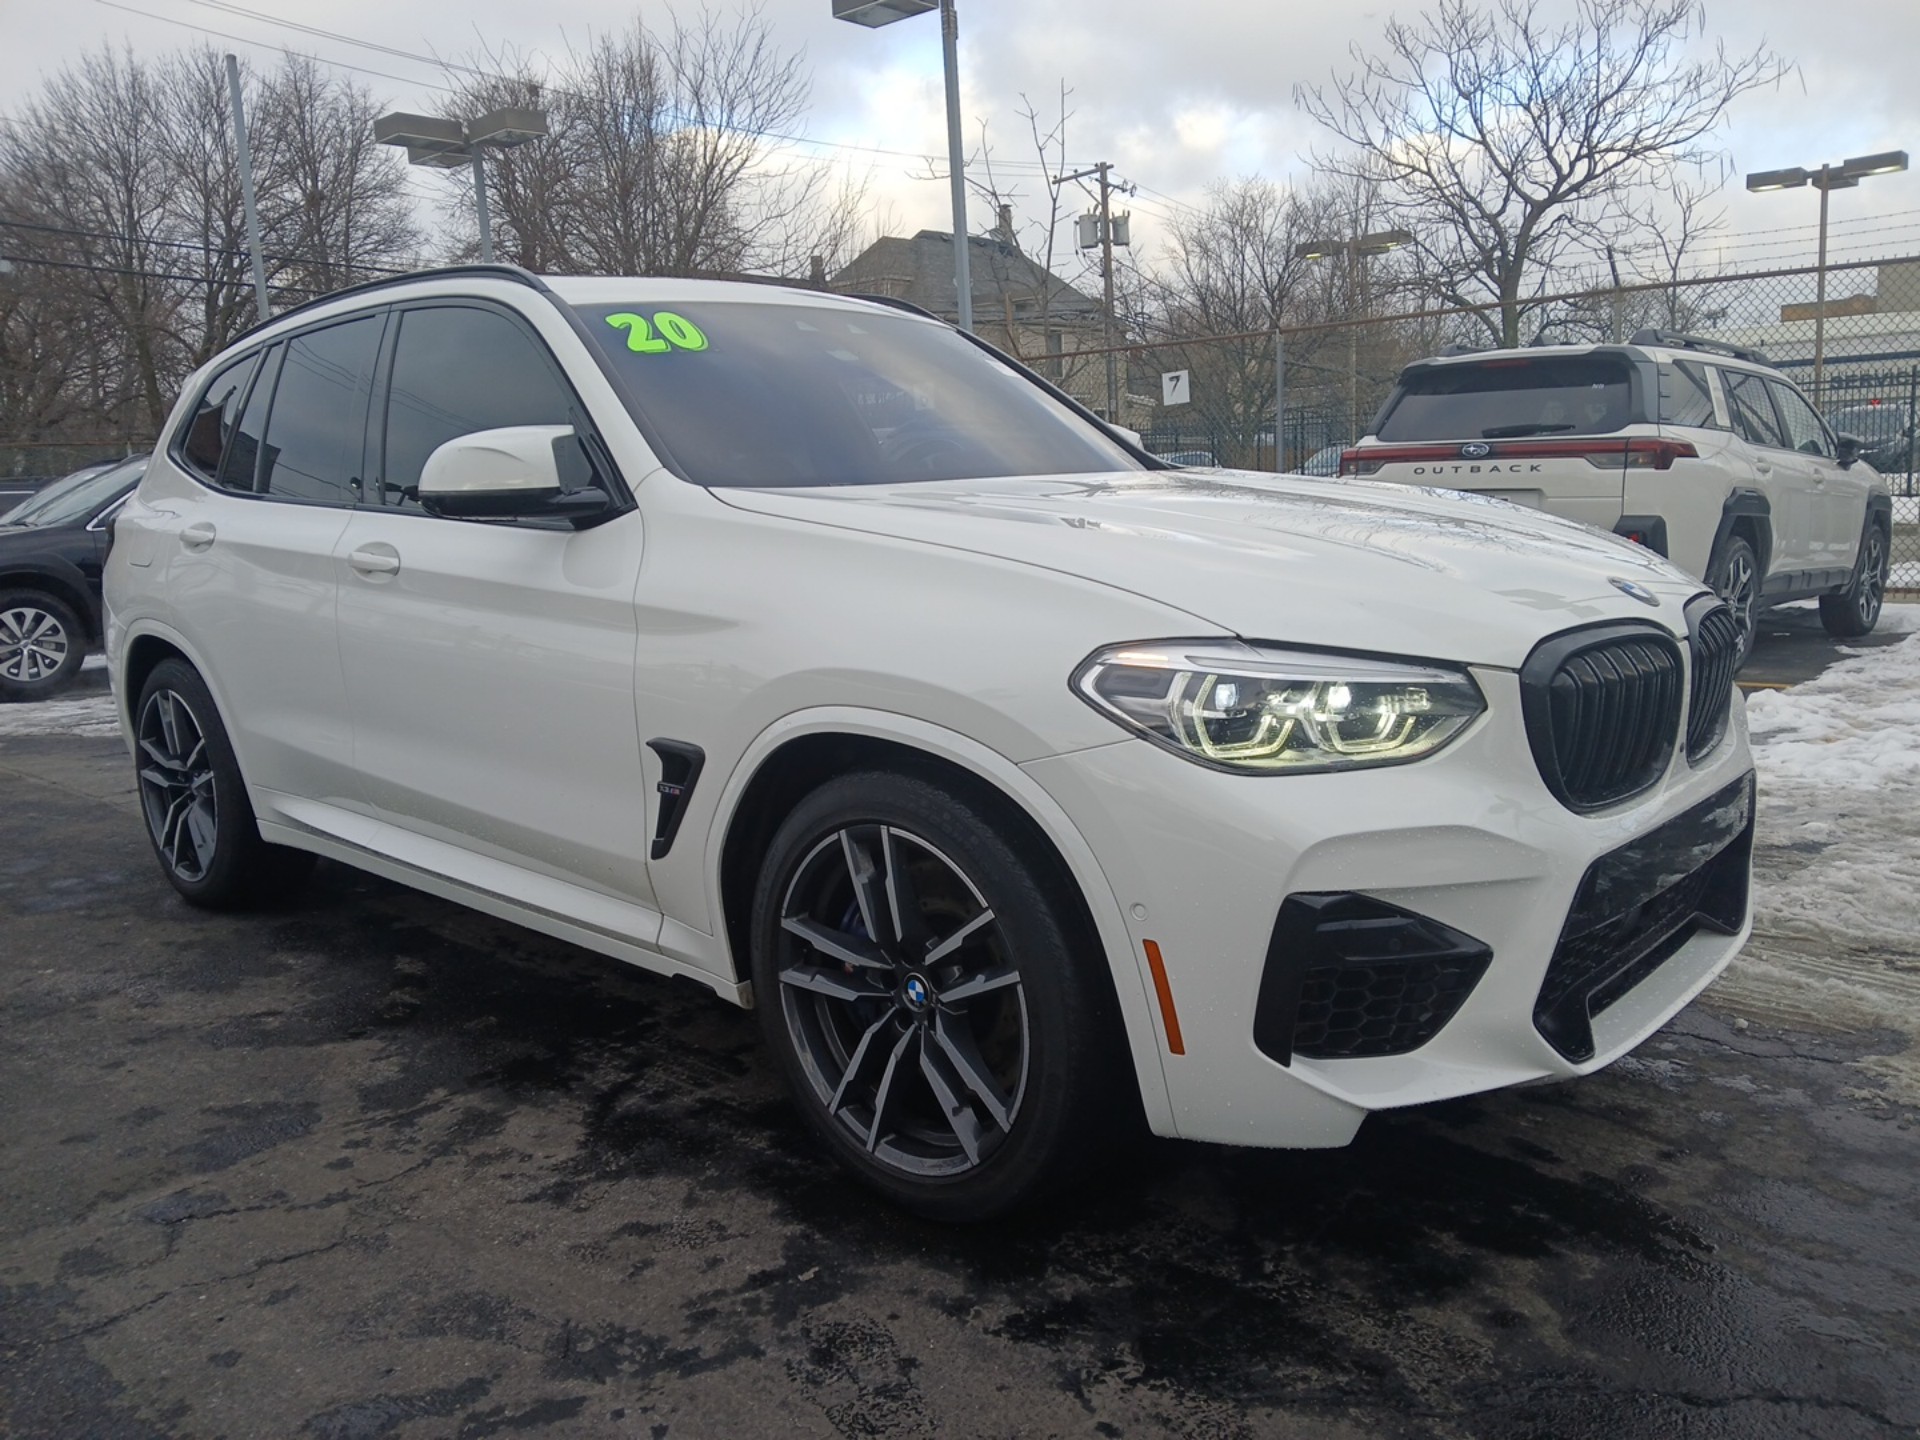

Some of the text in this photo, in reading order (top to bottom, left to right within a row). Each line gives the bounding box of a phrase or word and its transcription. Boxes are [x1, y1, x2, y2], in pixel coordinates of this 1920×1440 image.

[605, 311, 709, 353] 20
[1168, 375, 1181, 397] 7
[1830, 371, 1919, 389] SERVIC
[1413, 464, 1542, 475] OUTBACK
